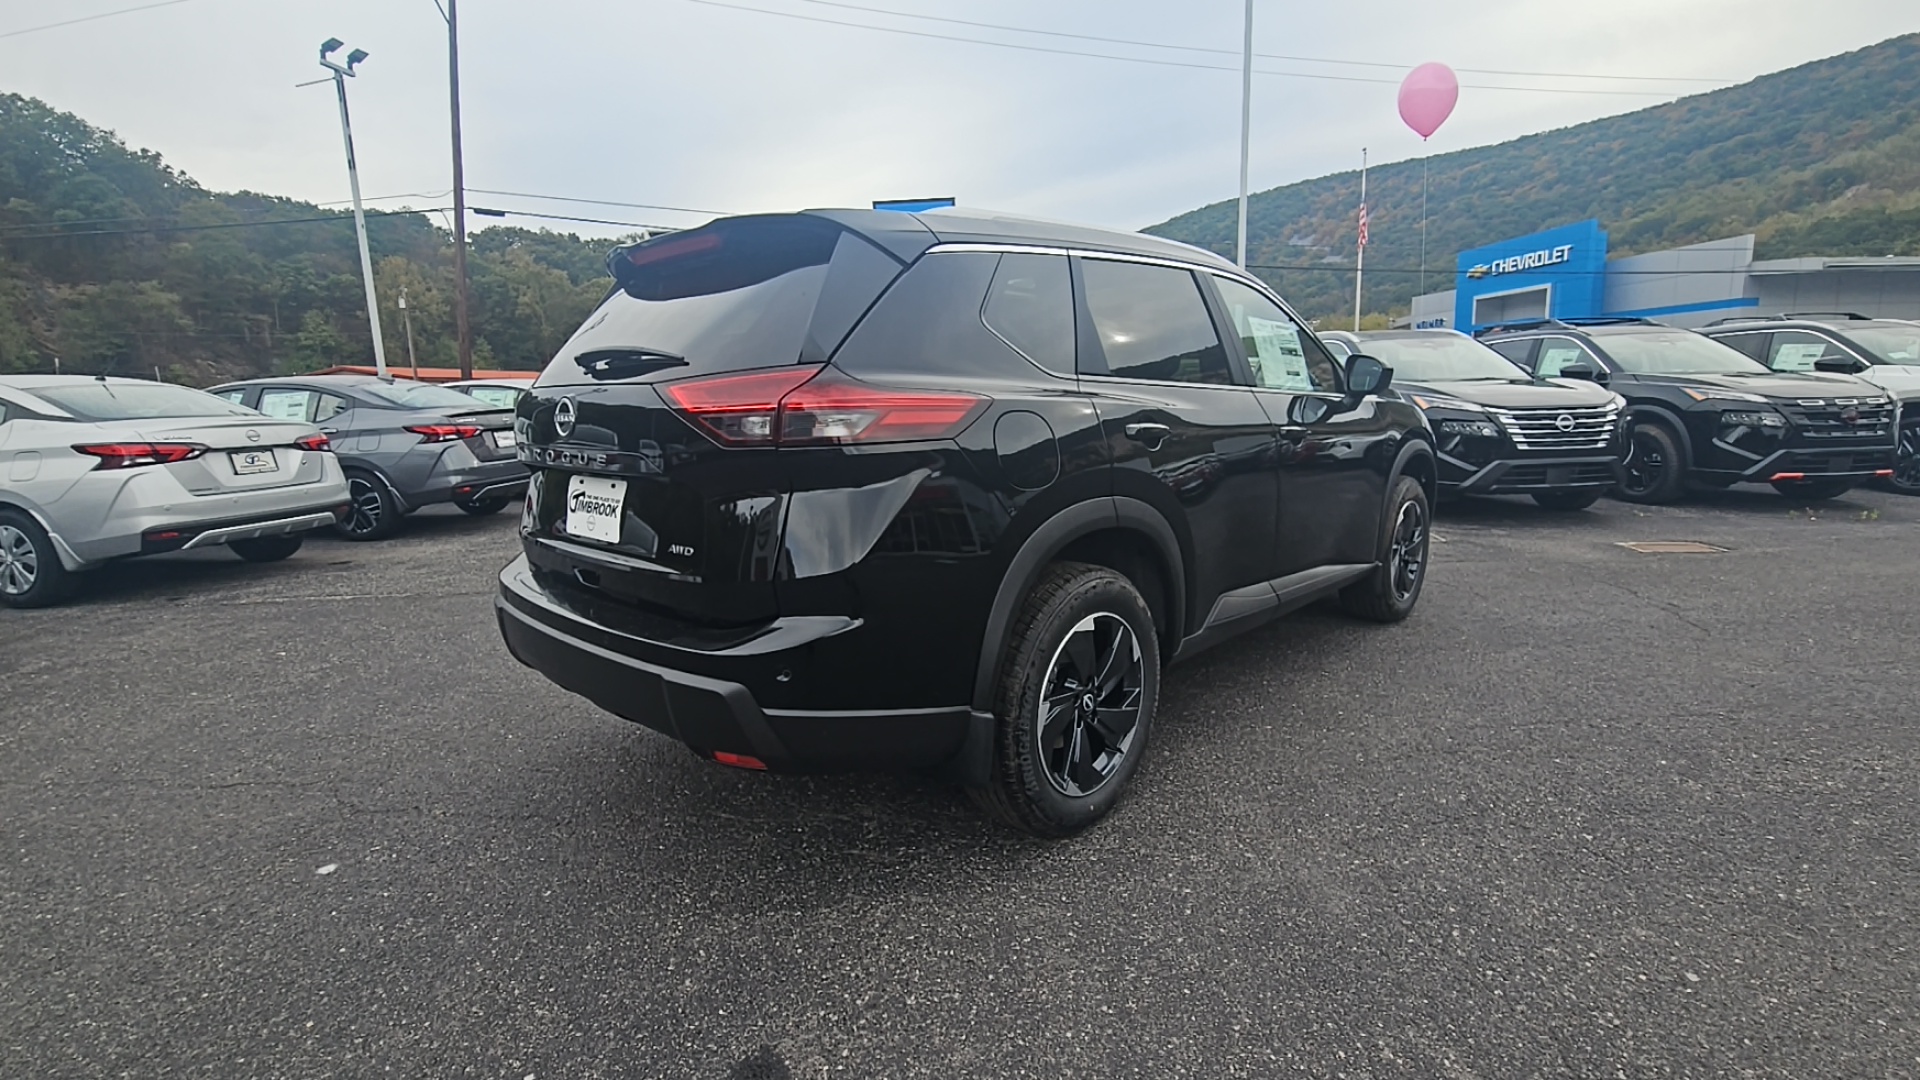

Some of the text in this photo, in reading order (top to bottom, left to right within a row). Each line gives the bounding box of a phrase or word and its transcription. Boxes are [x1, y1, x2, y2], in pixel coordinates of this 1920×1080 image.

[1491, 244, 1573, 276] CHEVROLET
[533, 449, 607, 467] ROGUE
[570, 490, 618, 518] TIMBROOK
[668, 543, 695, 557] AWD
